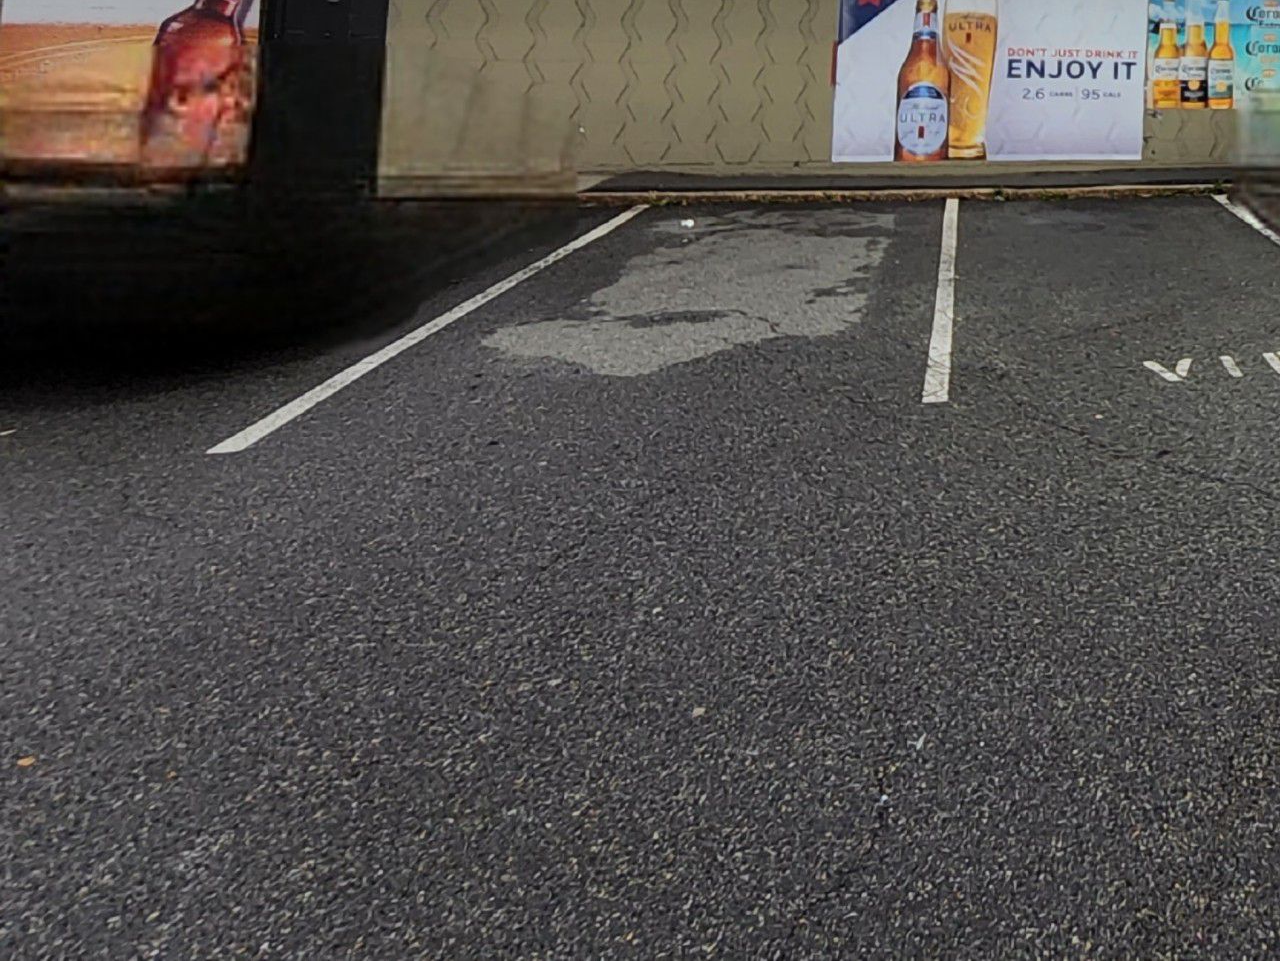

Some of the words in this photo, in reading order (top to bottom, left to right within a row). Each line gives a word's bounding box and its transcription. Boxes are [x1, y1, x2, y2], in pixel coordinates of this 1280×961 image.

[949, 21, 992, 32] ULTRA
[1007, 47, 1047, 58] DON'T
[1051, 48, 1081, 58] JUST
[1085, 49, 1123, 59] DRINK
[1127, 50, 1138, 59] IT
[1006, 58, 1103, 80] ENJOY
[1113, 61, 1138, 80] IT
[1022, 88, 1046, 100] 2.6
[1081, 88, 1101, 100] 95
[900, 112, 946, 124] ULTRA
